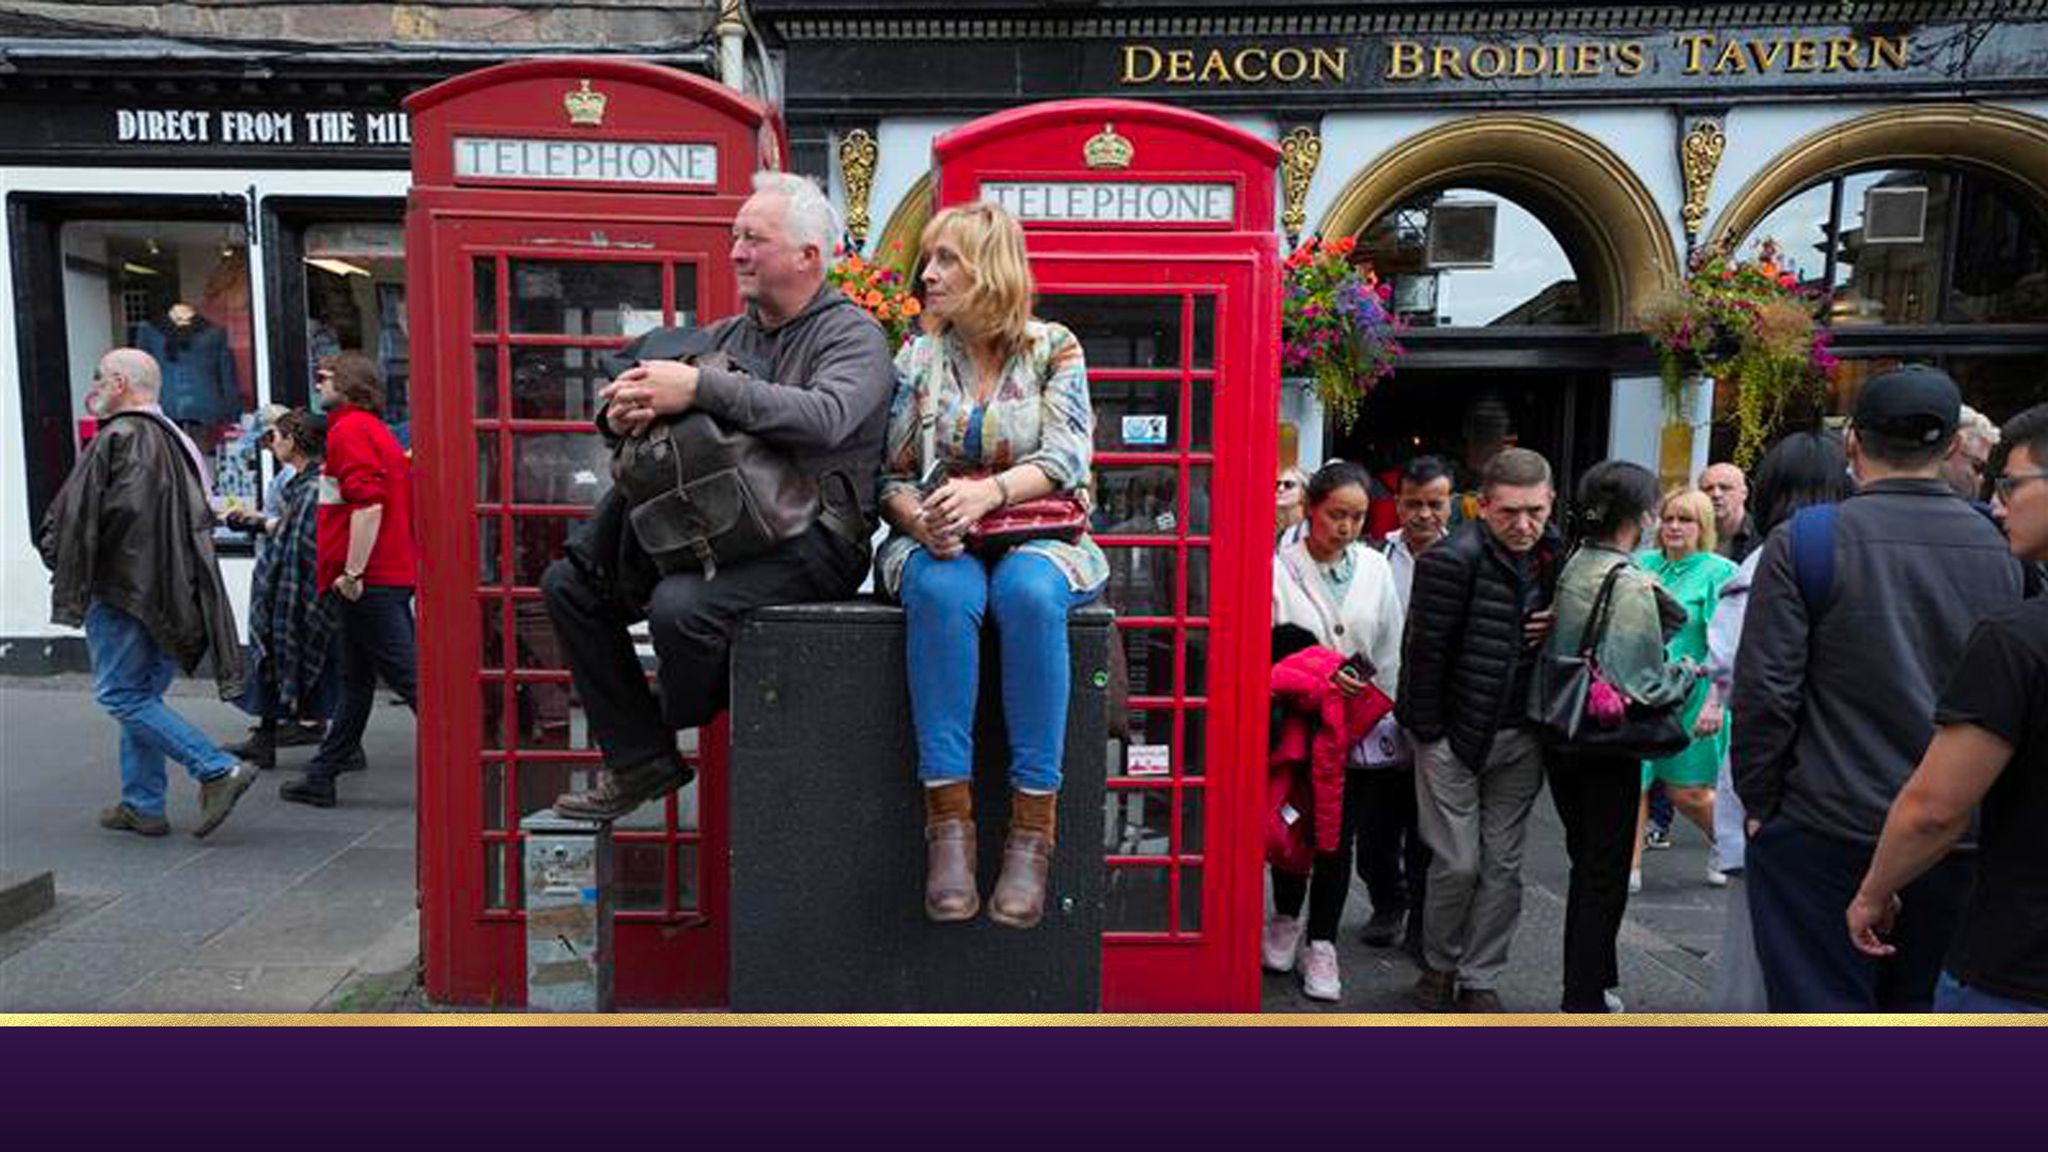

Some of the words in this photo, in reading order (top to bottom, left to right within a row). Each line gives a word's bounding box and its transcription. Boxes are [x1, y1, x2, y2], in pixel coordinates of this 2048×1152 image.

[1120, 45, 1348, 83] DEACON
[1385, 40, 1645, 80] BRODIE'S
[1678, 35, 1912, 74] TAVERN
[116, 110, 210, 141] DIRECT
[220, 111, 294, 143] FROM
[305, 112, 356, 143] THE
[464, 141, 708, 179] TELEPHONE
[990, 186, 1223, 220] TELEPHONE
